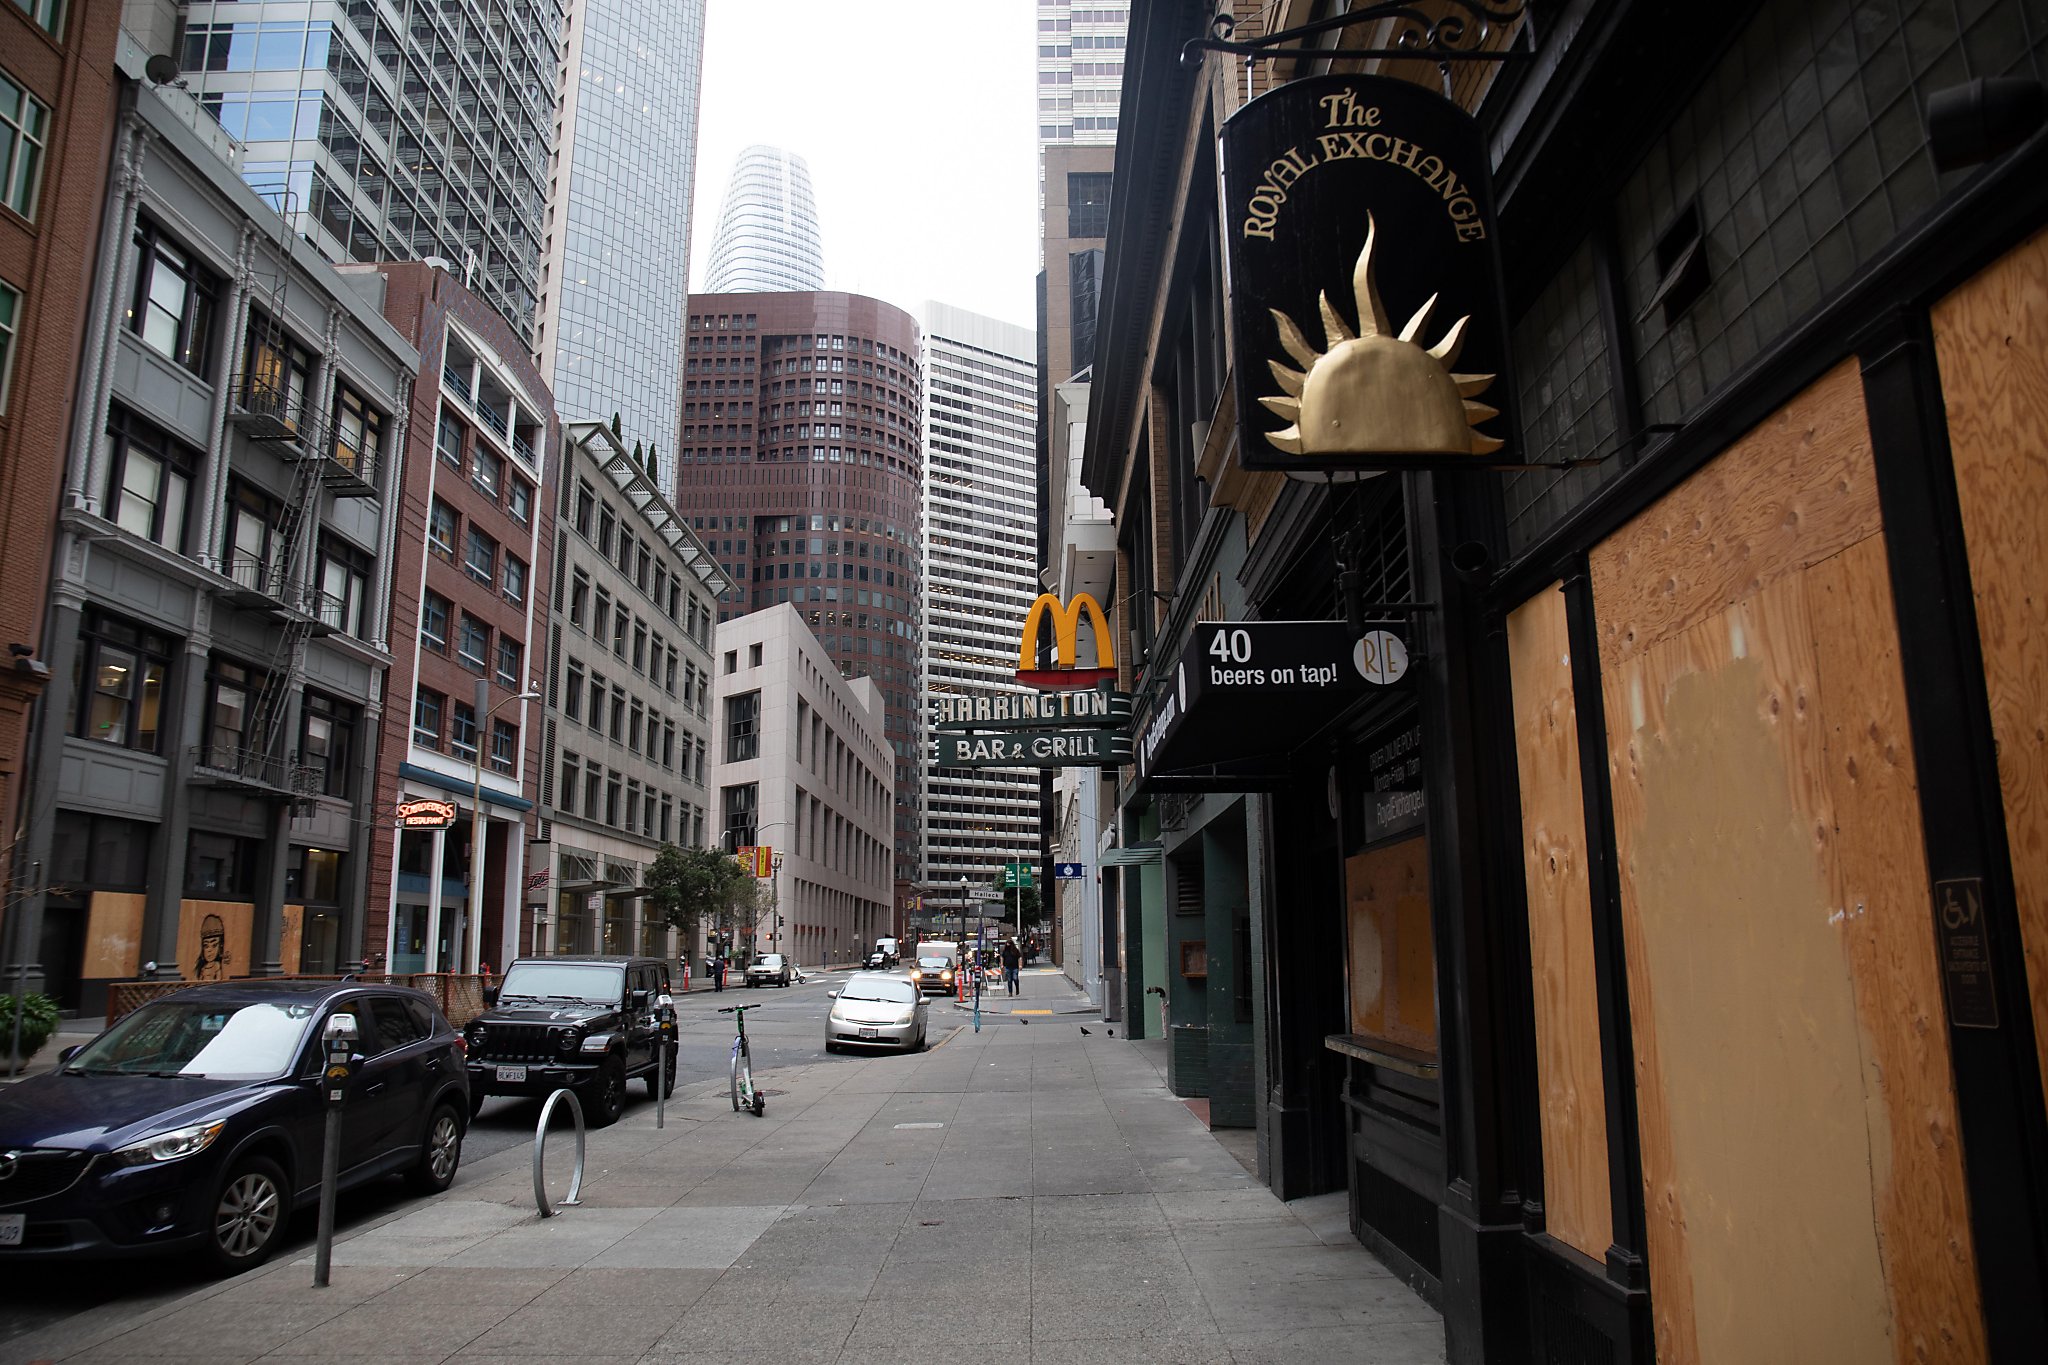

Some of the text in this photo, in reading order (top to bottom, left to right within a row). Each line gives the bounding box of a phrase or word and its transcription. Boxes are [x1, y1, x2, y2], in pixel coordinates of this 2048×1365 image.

[1319, 87, 1381, 128] The
[1244, 132, 1486, 243] ROYAL EXCHANGE
[1209, 629, 1252, 663] 40
[1211, 663, 1338, 687] beers on tap!
[938, 692, 1108, 722] HARRINGTON
[956, 735, 1100, 761] BAR & GRILL
